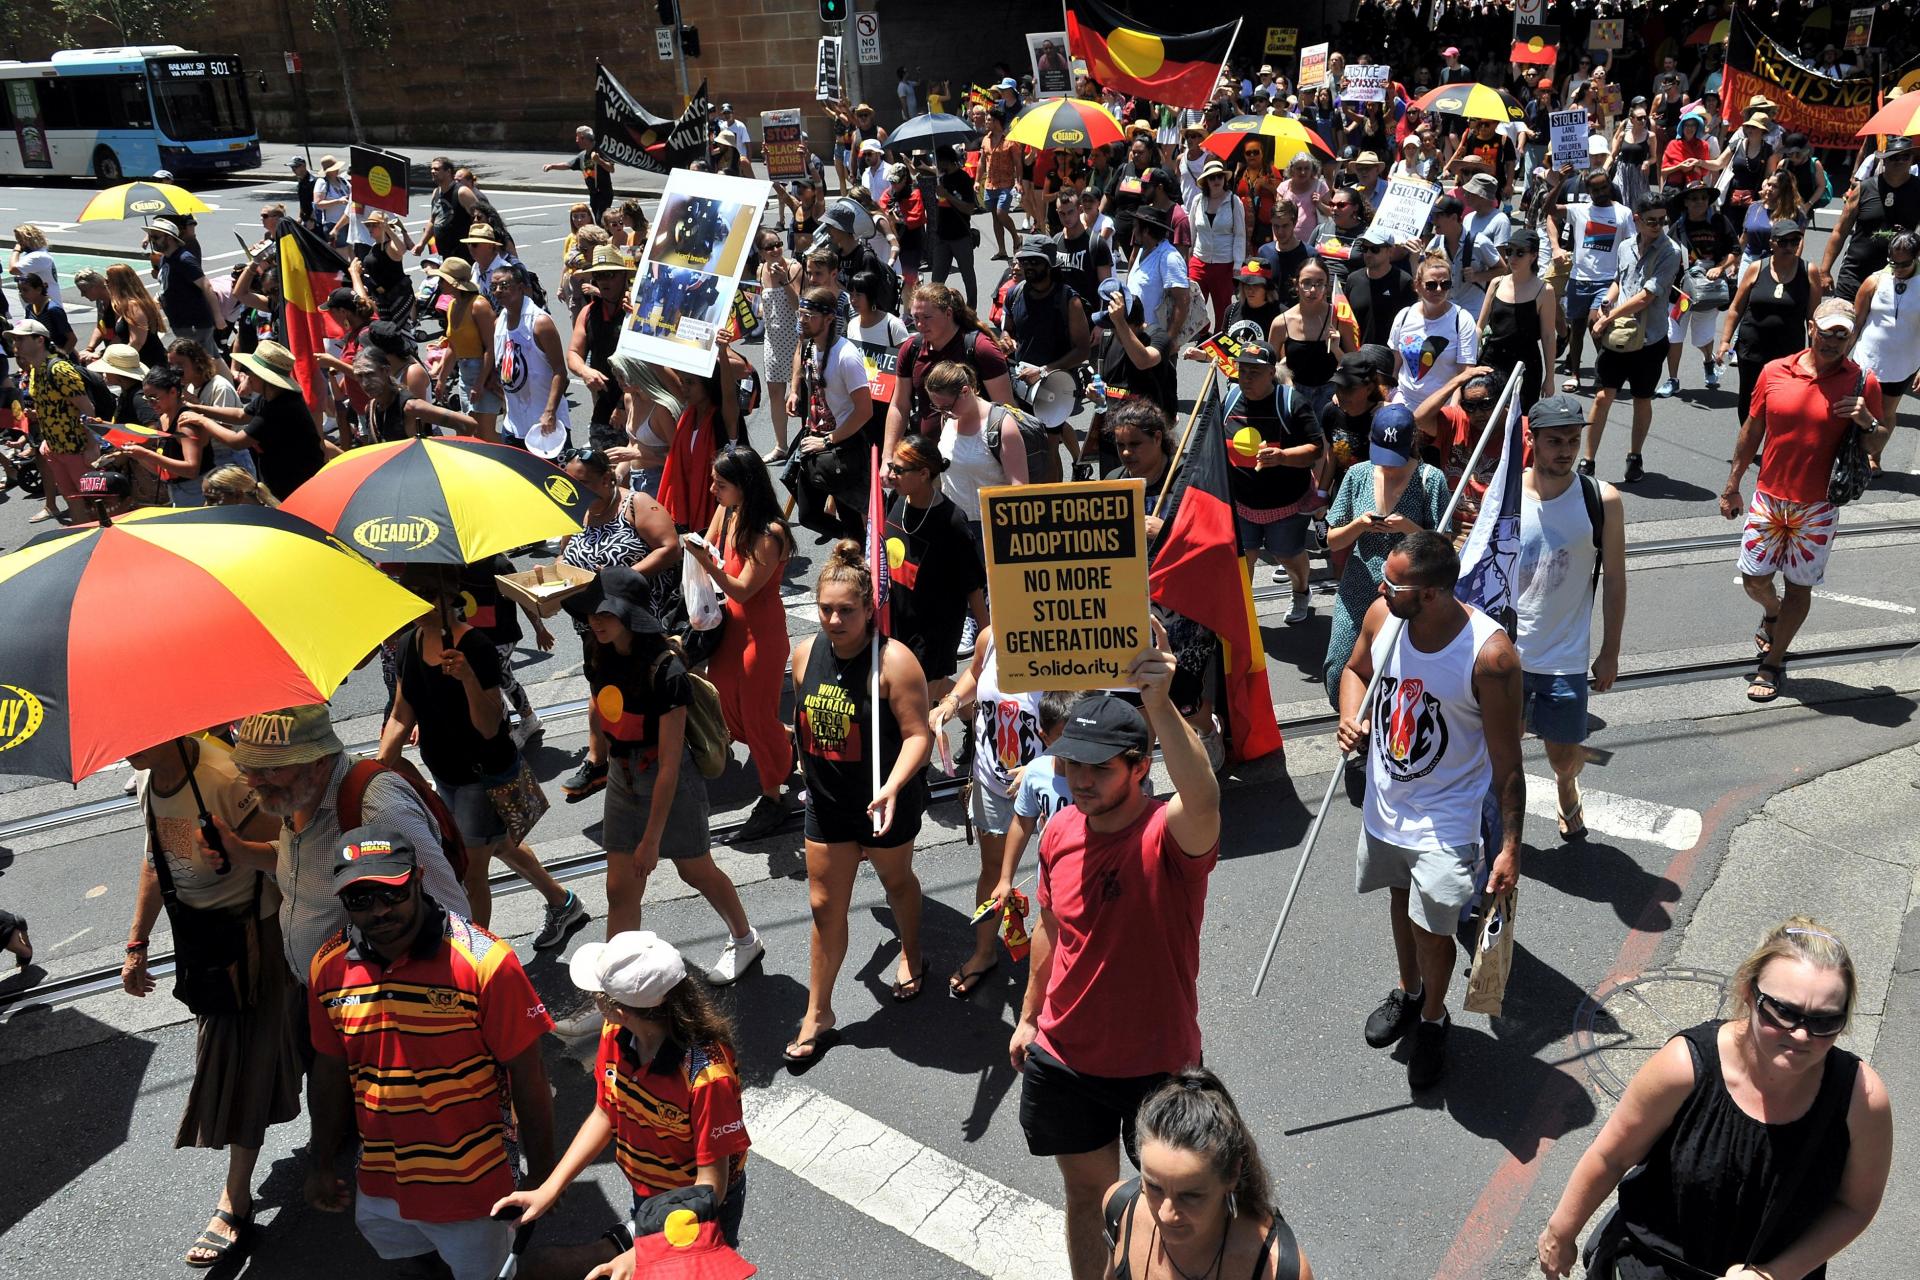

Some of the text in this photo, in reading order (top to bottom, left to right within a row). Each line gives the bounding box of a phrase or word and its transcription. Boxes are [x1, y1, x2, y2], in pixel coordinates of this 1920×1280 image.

[1520, 15, 1535, 25] NO
[658, 31, 669, 40] ONE
[861, 38, 875, 46] NO
[659, 41, 671, 49] WAY
[210, 61, 230, 75] 501
[1552, 112, 1584, 126] STOLEN
[767, 128, 798, 141] STOP
[1057, 131, 1079, 141] DEADLY
[1561, 126, 1575, 134] LAND
[767, 143, 801, 155] BLACK
[1558, 143, 1582, 151] CHILDREN
[769, 155, 801, 166] DEATHS
[1391, 183, 1434, 205] STOLEN
[1583, 242, 1611, 251] LACOSTE
[1248, 321, 1263, 338] RADIO
[995, 495, 1129, 526] STOP FORCED
[369, 523, 425, 543] DEADLY
[1009, 528, 1120, 557] ADOPTIONS
[1024, 566, 1112, 593] NO MORE
[1033, 598, 1107, 622] STOLEN
[1006, 626, 1138, 654] GENERATIONS
[1027, 658, 1119, 679] Solidarity
[817, 683, 849, 699] WHITE
[803, 694, 856, 716] AUSTRALIA
[0, 699, 25, 737] LY
[813, 711, 832, 724] HAS
[239, 713, 295, 746] RWAY
[812, 724, 845, 740] BLACK
[722, 1119, 746, 1135] CSM
